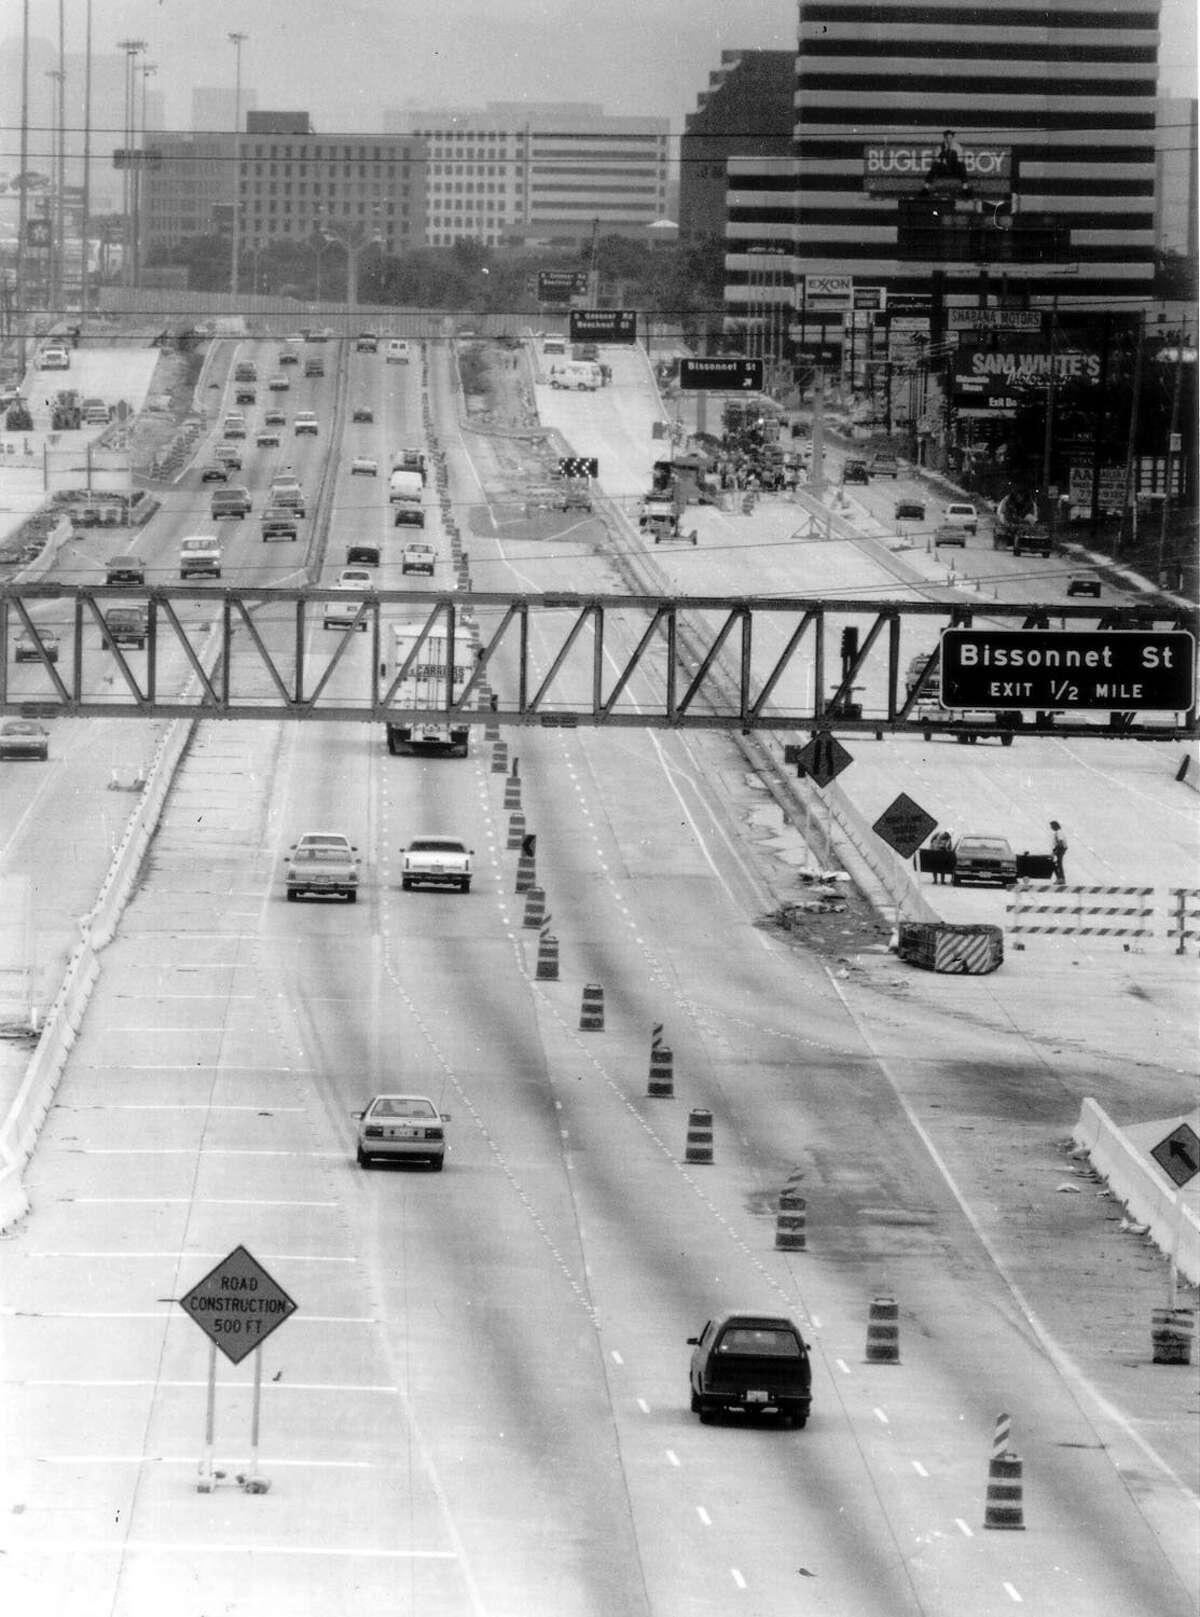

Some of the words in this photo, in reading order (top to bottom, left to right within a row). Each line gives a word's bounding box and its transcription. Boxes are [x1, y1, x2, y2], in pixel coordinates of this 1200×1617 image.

[868, 150, 933, 172] BUGLE
[965, 151, 1006, 173] BOY
[808, 279, 850, 293] EXXON
[687, 362, 737, 371] Bissonnet
[745, 362, 757, 371] St
[972, 352, 1015, 375] SAM
[1018, 353, 1101, 376] WHITE'S
[960, 644, 1113, 668] Bissonnet
[1141, 646, 1174, 669] St
[990, 682, 1034, 697] EXIT
[1050, 680, 1079, 700] 1/2
[1096, 683, 1144, 698] MILE
[221, 1276, 259, 1292] ROAD
[190, 1295, 287, 1314] CONSTRUCTION
[214, 1319, 242, 1334] 500
[246, 1319, 263, 1335] FT
